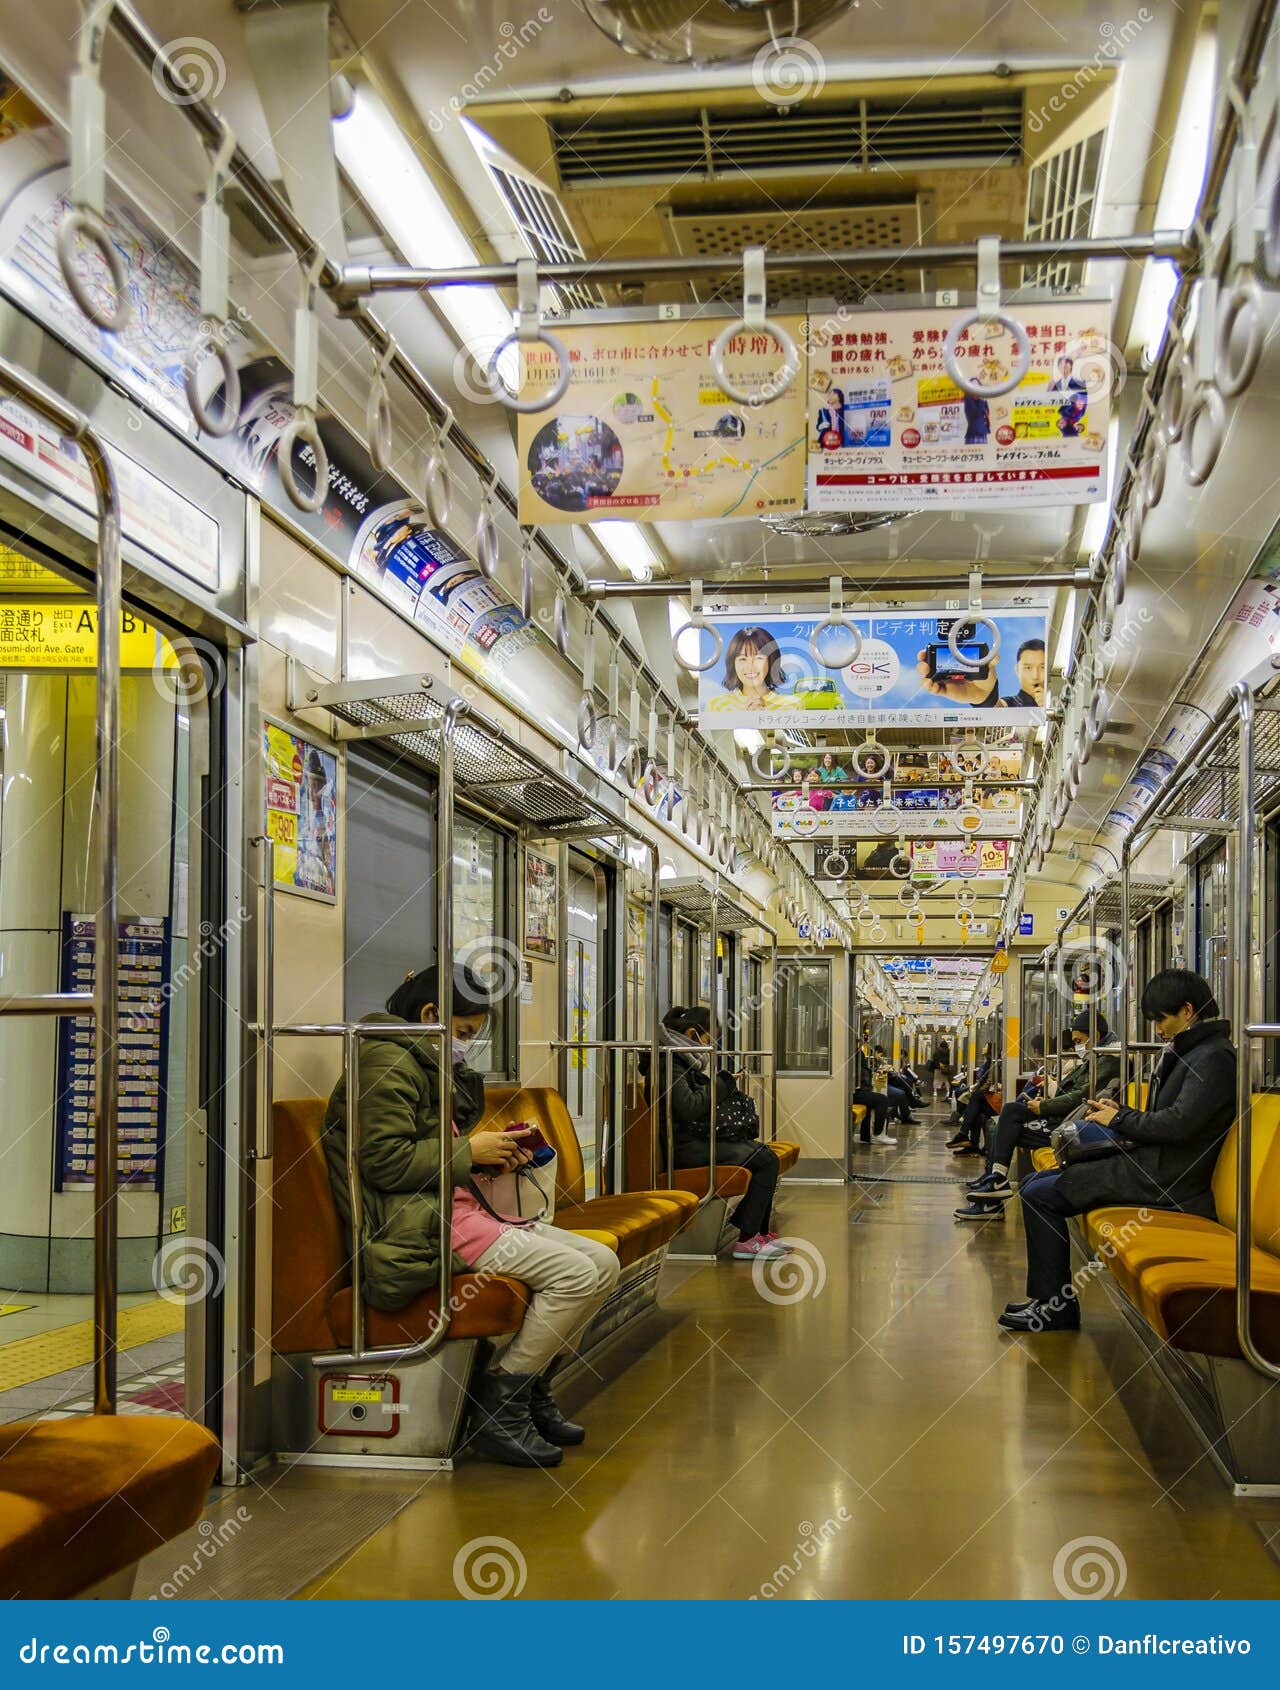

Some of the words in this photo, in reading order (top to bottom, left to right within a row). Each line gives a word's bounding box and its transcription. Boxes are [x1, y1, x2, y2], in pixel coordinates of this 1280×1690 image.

[942, 294, 951, 304] 6
[666, 307, 674, 317] 5
[831, 349, 886, 363] 眼の疲れ
[912, 344, 995, 359] からの疲れ
[53, 610, 73, 619] 出口
[53, 621, 72, 629] Exit
[0, 627, 45, 642] 面改札
[44, 645, 63, 653] Ave.
[65, 645, 85, 653] Gate
[850, 662, 891, 674] GK
[1060, 910, 1068, 918] 9
